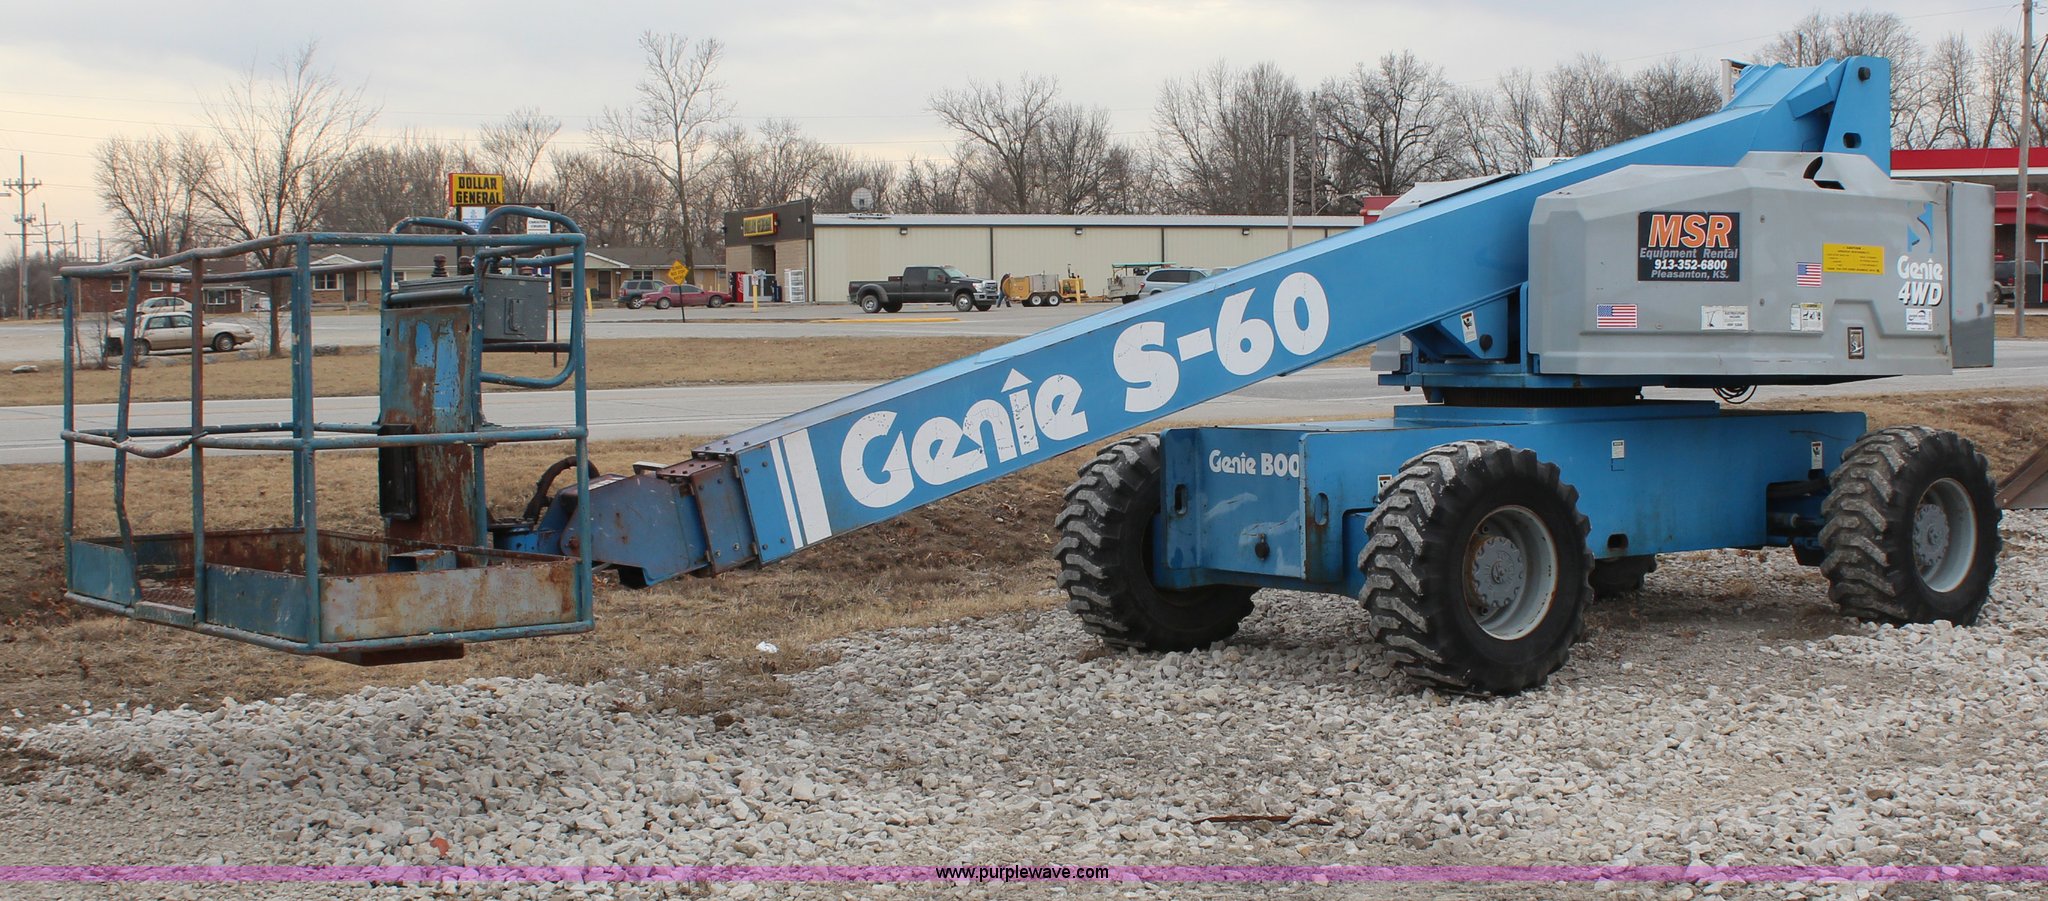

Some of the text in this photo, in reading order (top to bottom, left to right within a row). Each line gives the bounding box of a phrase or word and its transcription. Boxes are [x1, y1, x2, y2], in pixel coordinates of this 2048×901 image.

[458, 176, 497, 190] DOLLAR
[456, 191, 501, 204] GENERAL
[1648, 214, 1732, 248] MSR
[1640, 248, 1738, 259] Equipment Rental
[1654, 259, 1728, 270] 913-352-6800
[1897, 255, 1943, 280] Genie
[1651, 270, 1729, 280] Pleasanton, KS.
[1898, 281, 1944, 306] 4WD
[840, 272, 1330, 508] Genie S-60
[1208, 449, 1256, 475] Genie
